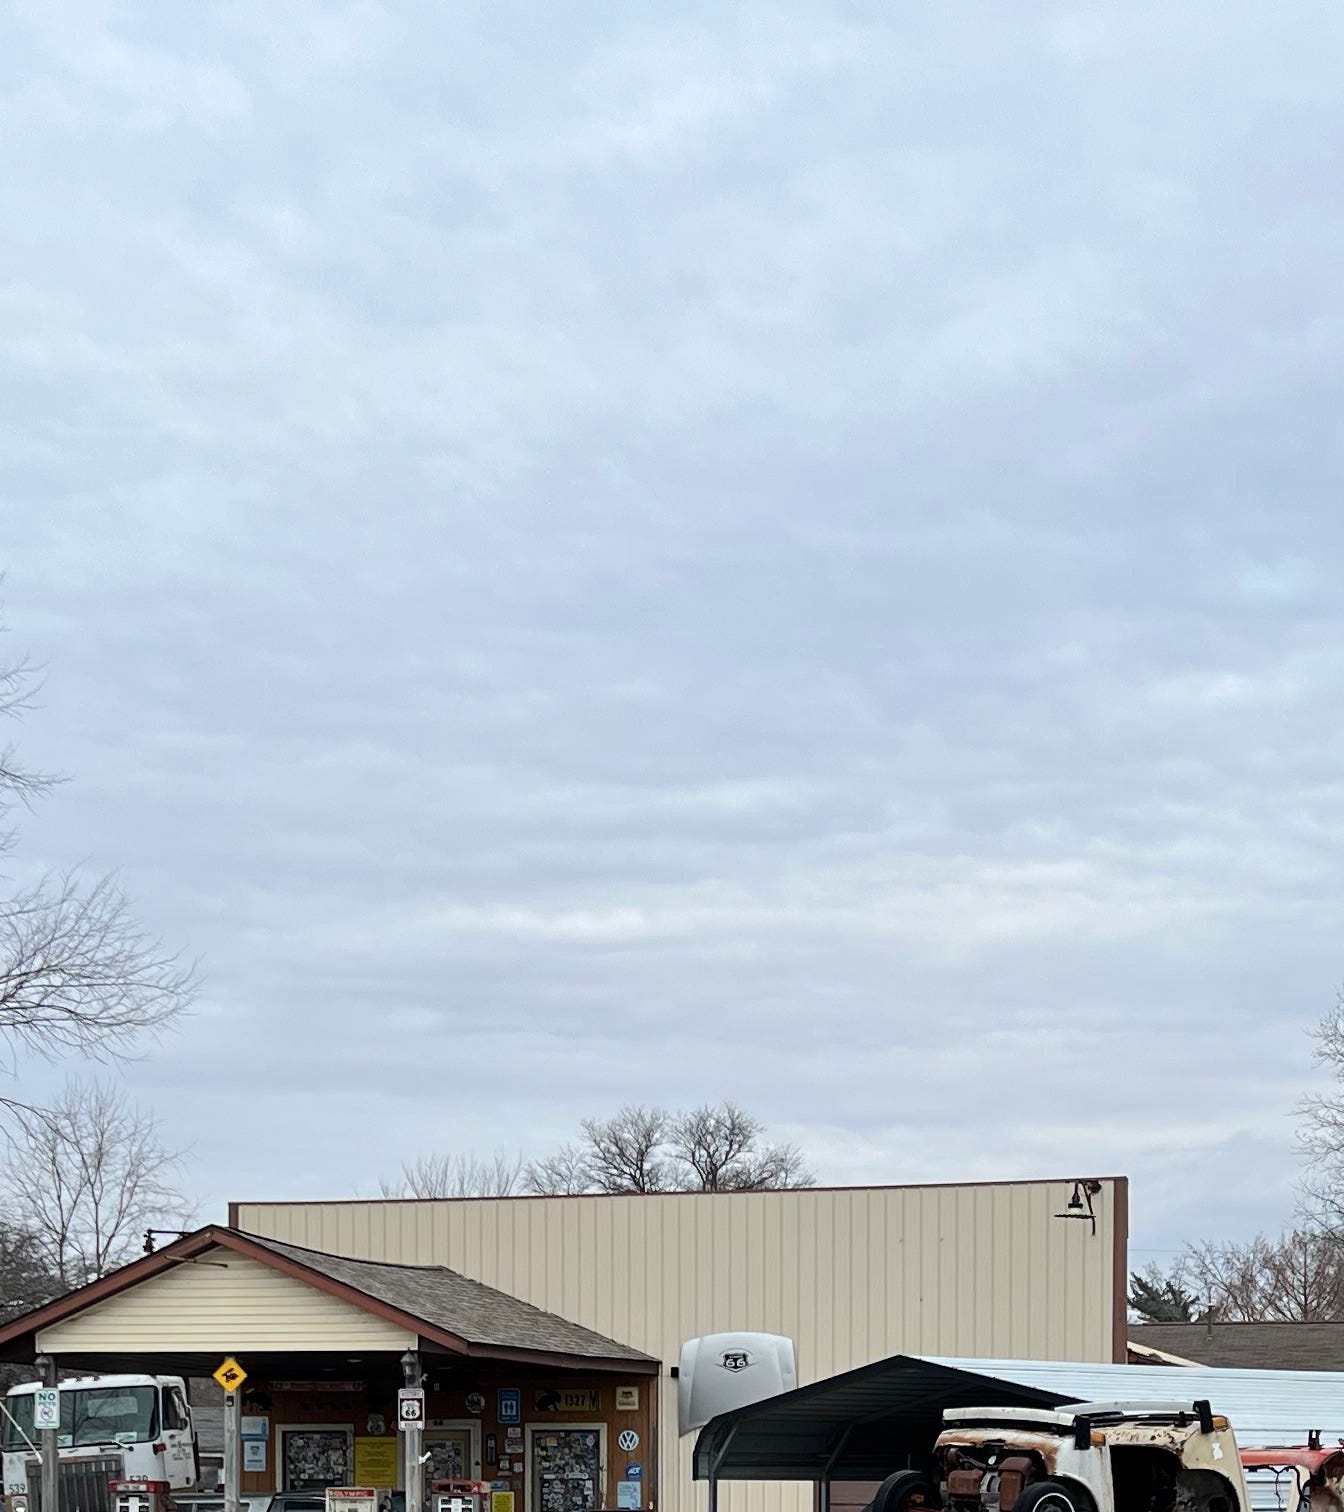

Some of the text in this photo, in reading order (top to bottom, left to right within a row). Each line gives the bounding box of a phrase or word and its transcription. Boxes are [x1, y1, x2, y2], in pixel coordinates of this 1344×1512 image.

[725, 1358, 746, 1368] 66
[38, 1392, 56, 1401] NO
[405, 1408, 417, 1417] 66
[9, 1483, 26, 1495] 539
